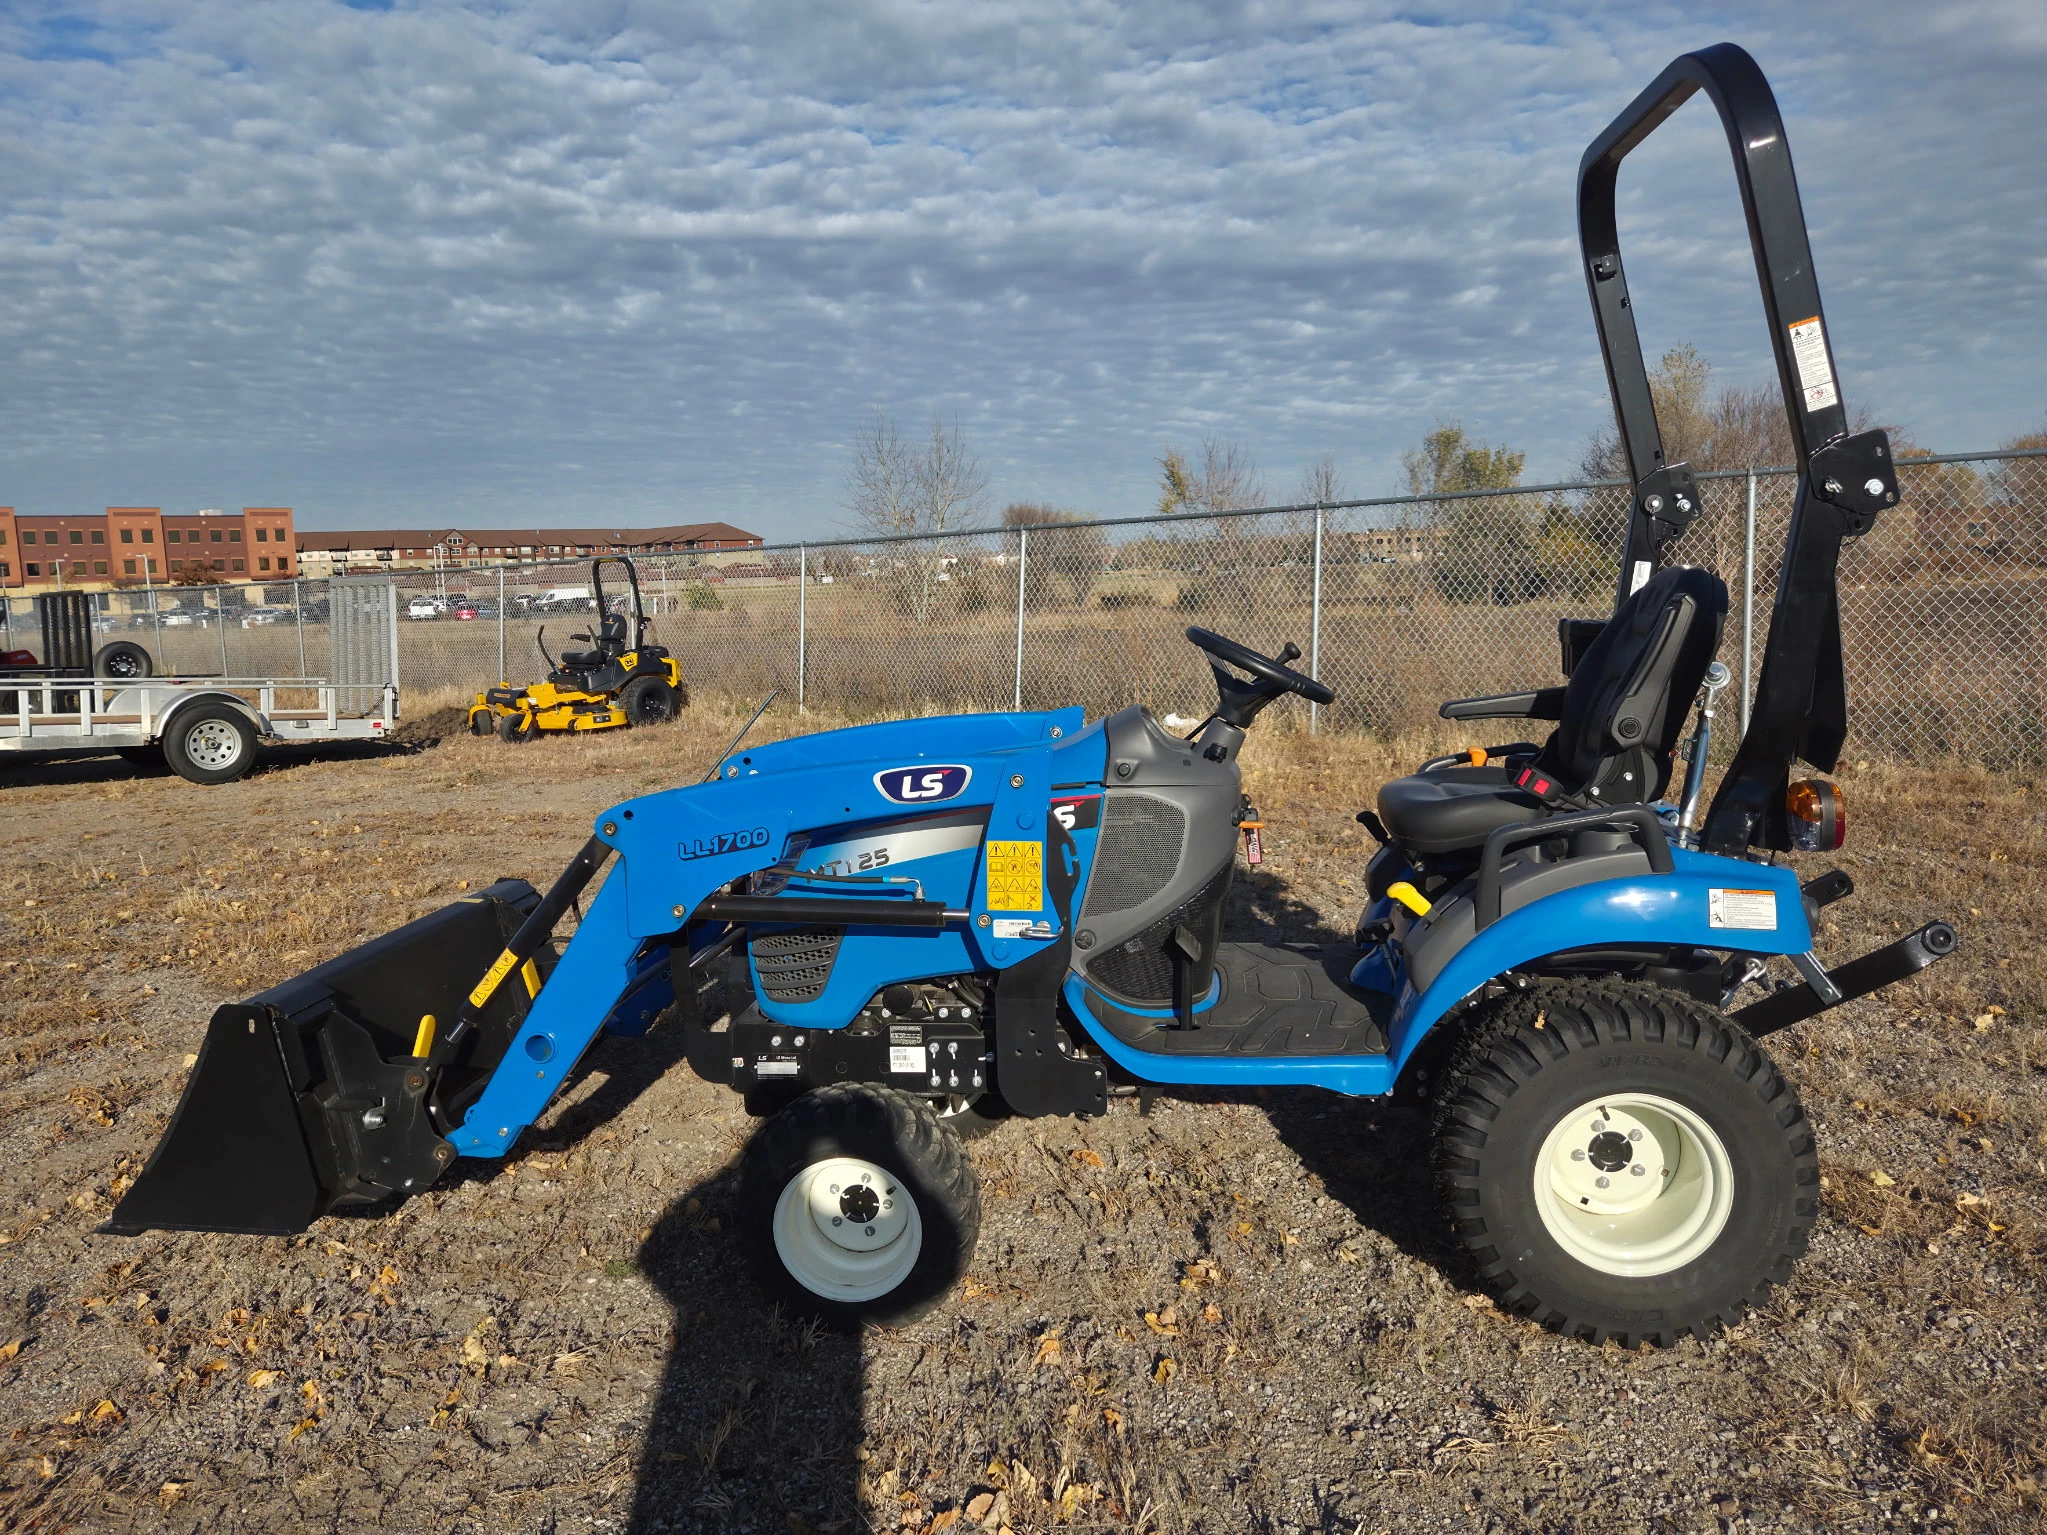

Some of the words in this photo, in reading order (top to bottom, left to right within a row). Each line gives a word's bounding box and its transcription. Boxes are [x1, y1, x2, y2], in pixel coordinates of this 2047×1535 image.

[901, 772, 944, 799] LS
[1053, 804, 1076, 830] S
[678, 827, 770, 861] LL1700
